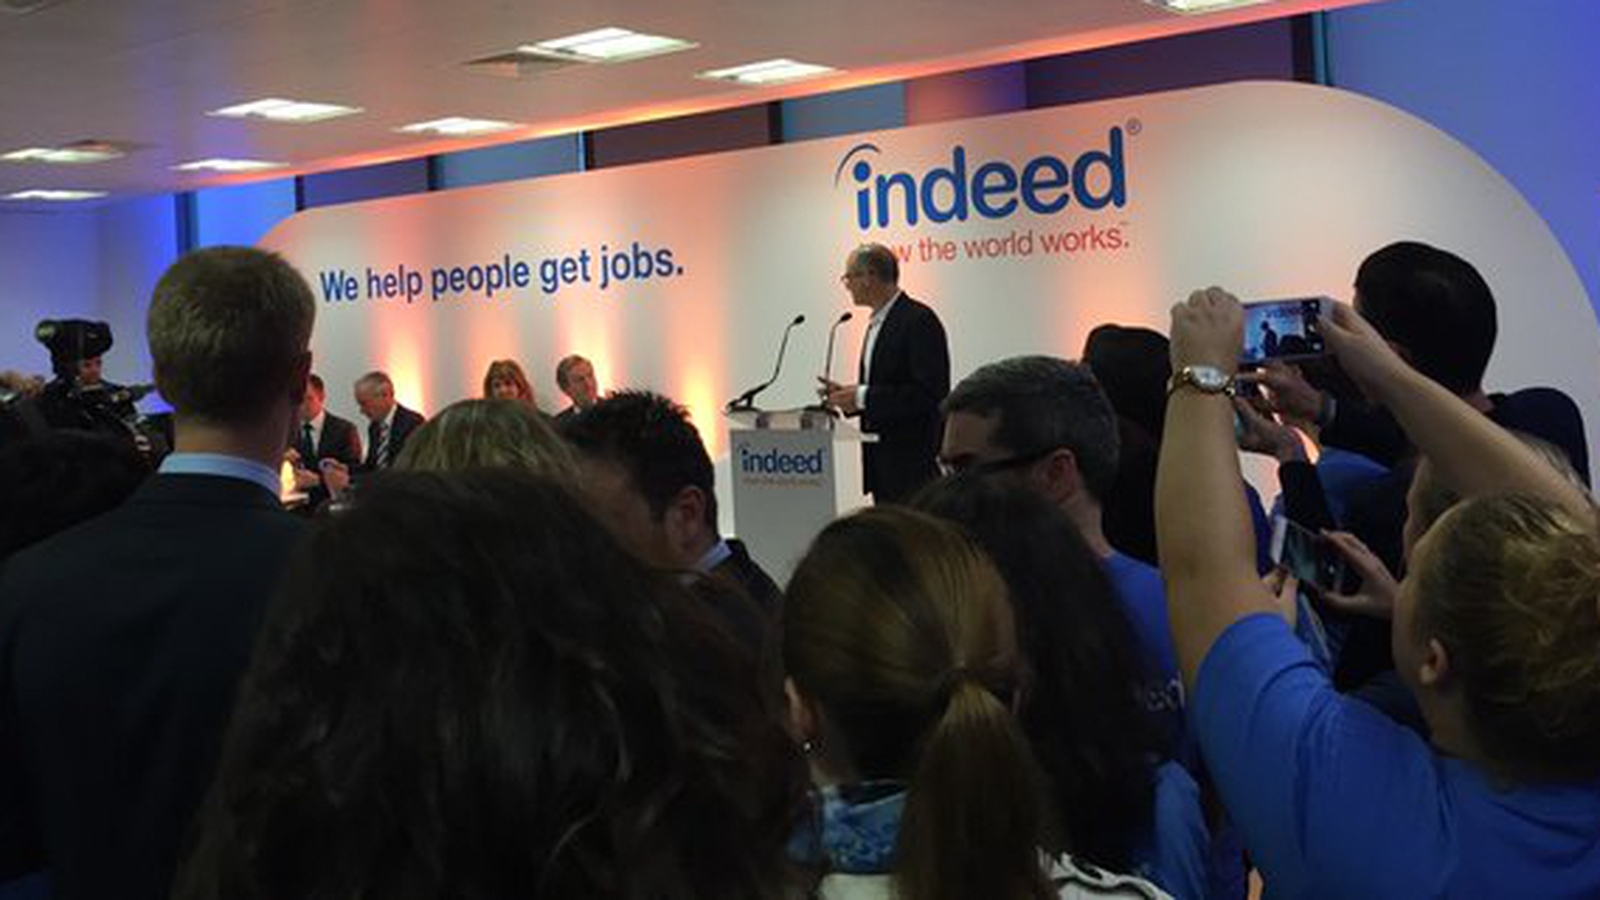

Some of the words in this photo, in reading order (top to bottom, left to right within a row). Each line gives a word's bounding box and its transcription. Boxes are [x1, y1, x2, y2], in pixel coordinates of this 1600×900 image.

[852, 125, 1127, 230] indeed
[918, 238, 956, 263] the
[963, 231, 1035, 258] world
[1040, 225, 1130, 254] works.
[318, 269, 359, 302] We
[366, 264, 423, 303] help
[430, 253, 530, 300] people
[539, 249, 591, 294] get
[599, 241, 684, 289] jobs.
[741, 448, 823, 474] indeed
